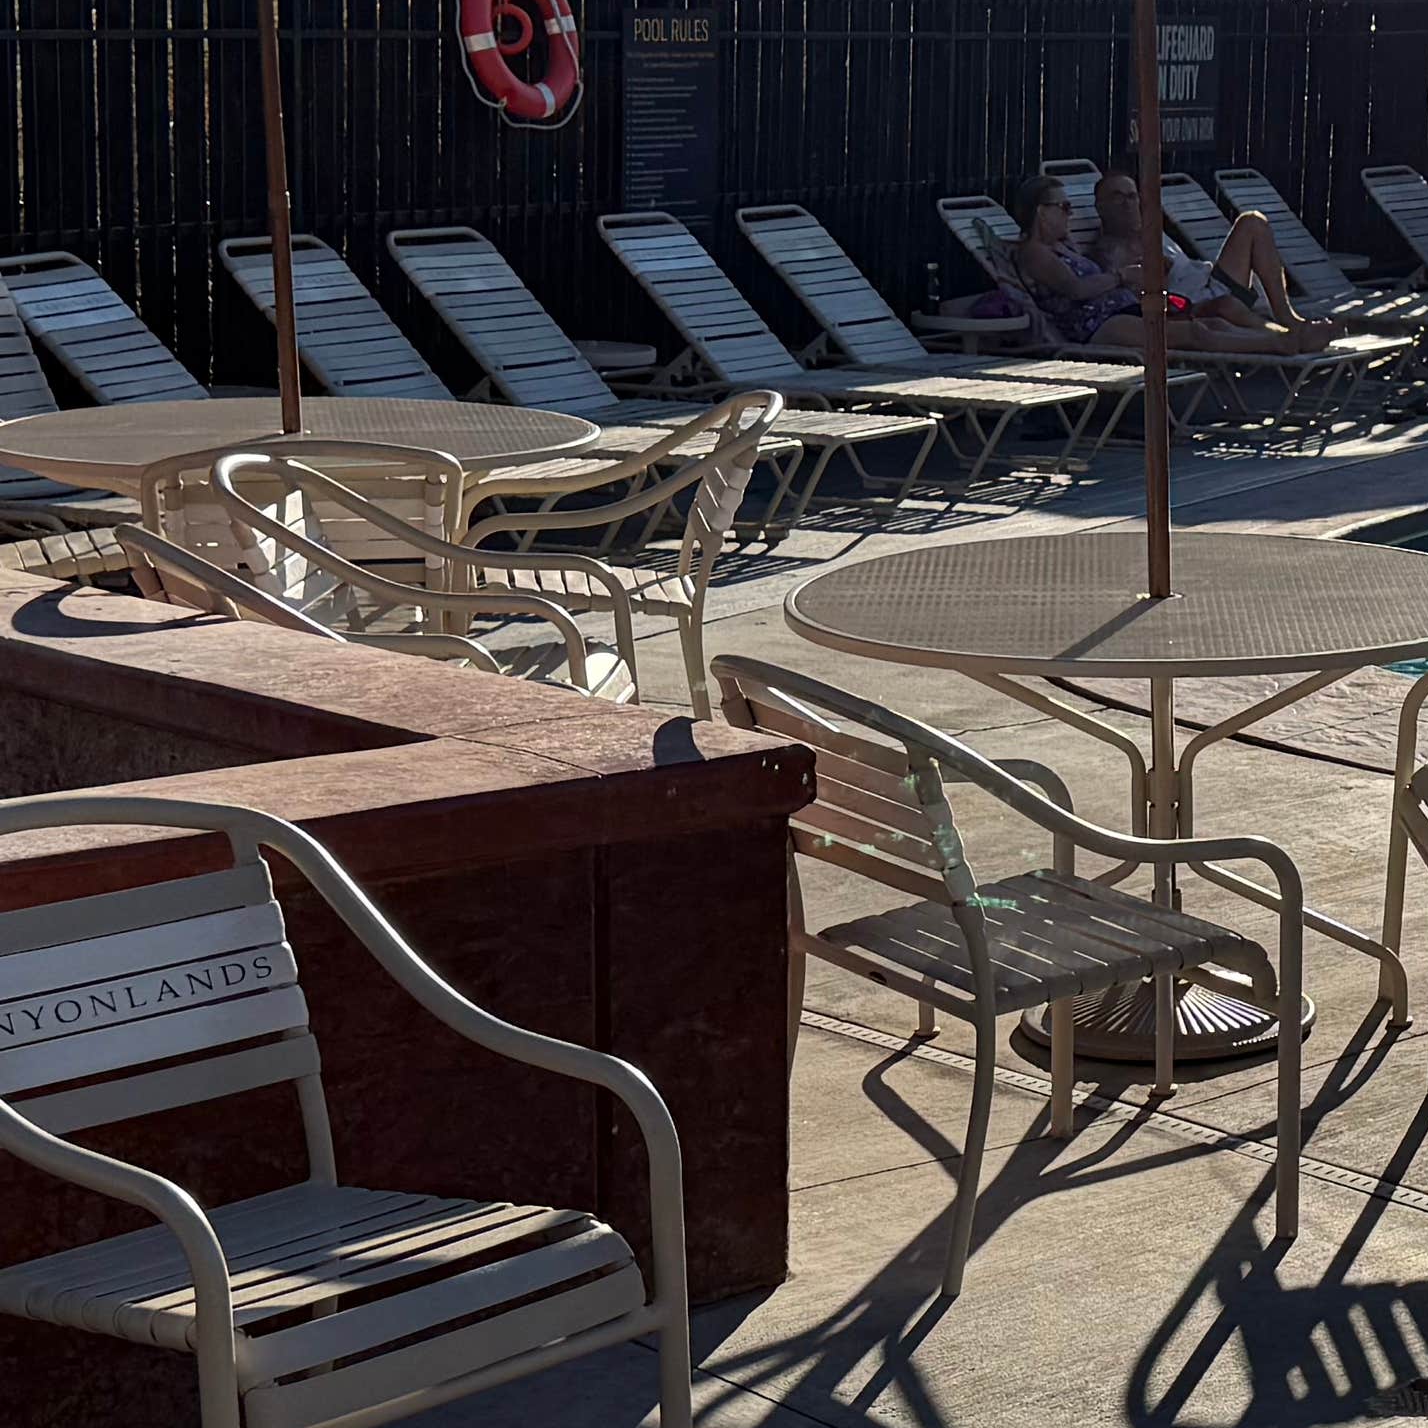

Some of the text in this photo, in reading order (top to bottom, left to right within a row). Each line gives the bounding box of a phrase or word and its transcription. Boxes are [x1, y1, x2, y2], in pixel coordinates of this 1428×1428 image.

[634, 18, 709, 42] POOL RULES
[1156, 25, 1215, 61] LIFEGUARD
[1158, 64, 1199, 101] N DUTY
